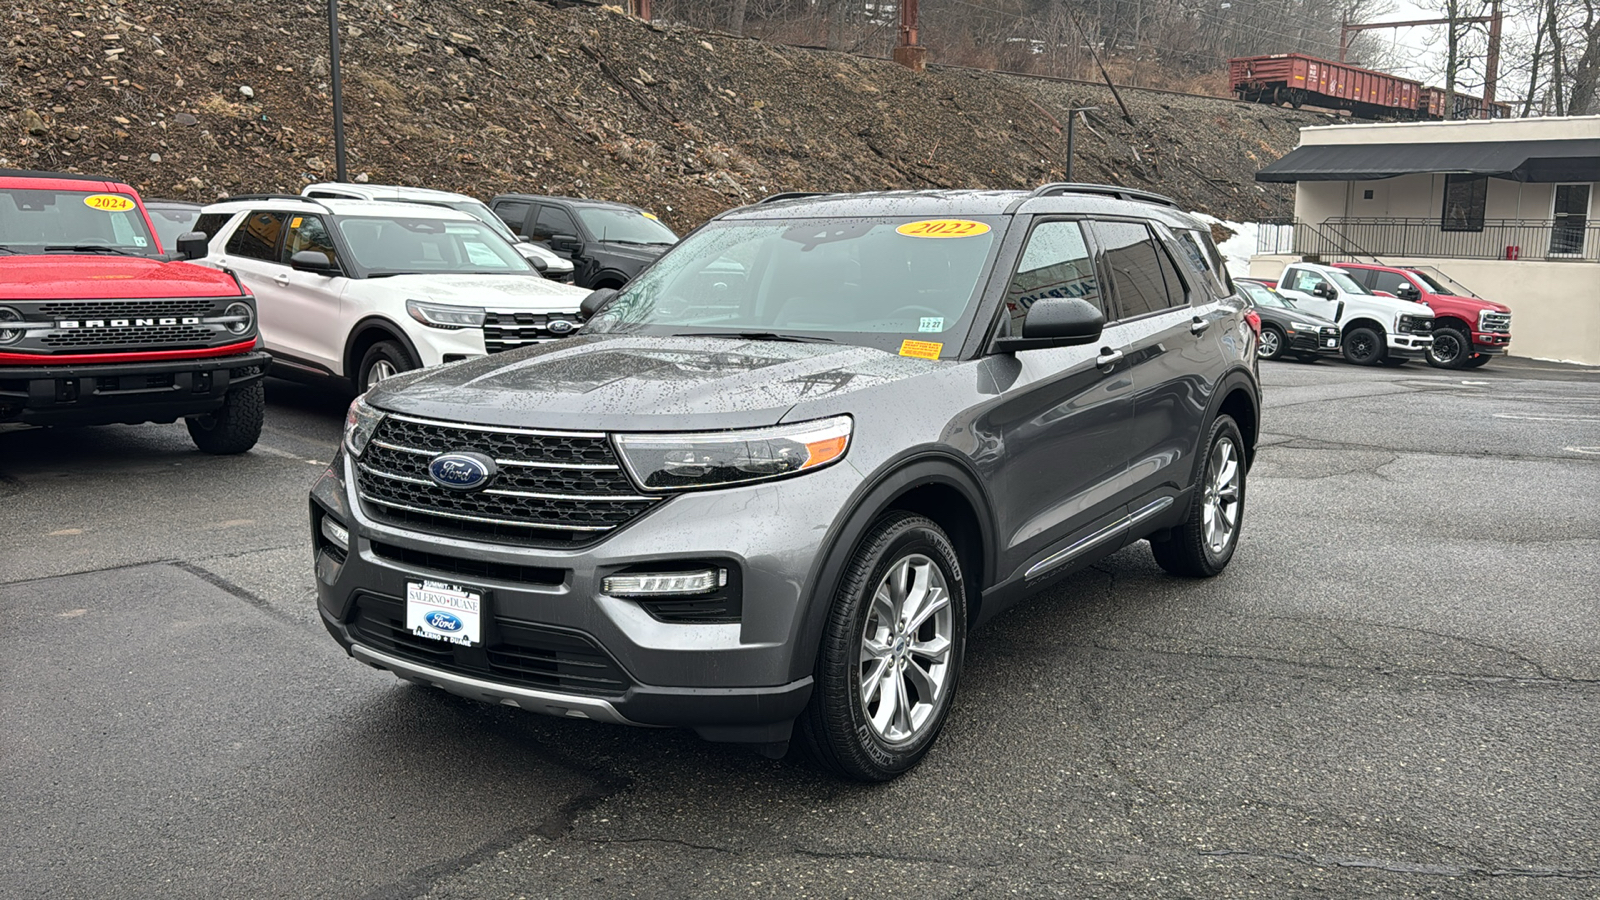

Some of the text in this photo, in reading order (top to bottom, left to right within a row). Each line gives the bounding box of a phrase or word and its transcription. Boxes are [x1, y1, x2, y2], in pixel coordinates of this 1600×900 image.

[94, 198, 127, 208] 2024
[909, 223, 976, 234] 2022
[59, 317, 199, 329] BRONCO
[439, 460, 473, 482] Ford
[936, 538, 960, 579] MICHELIN
[409, 590, 479, 611] SALERNO DUANE
[431, 613, 456, 630] Ford
[412, 629, 472, 647] SALERNO DUANE
[859, 727, 892, 766] MICHELIN
